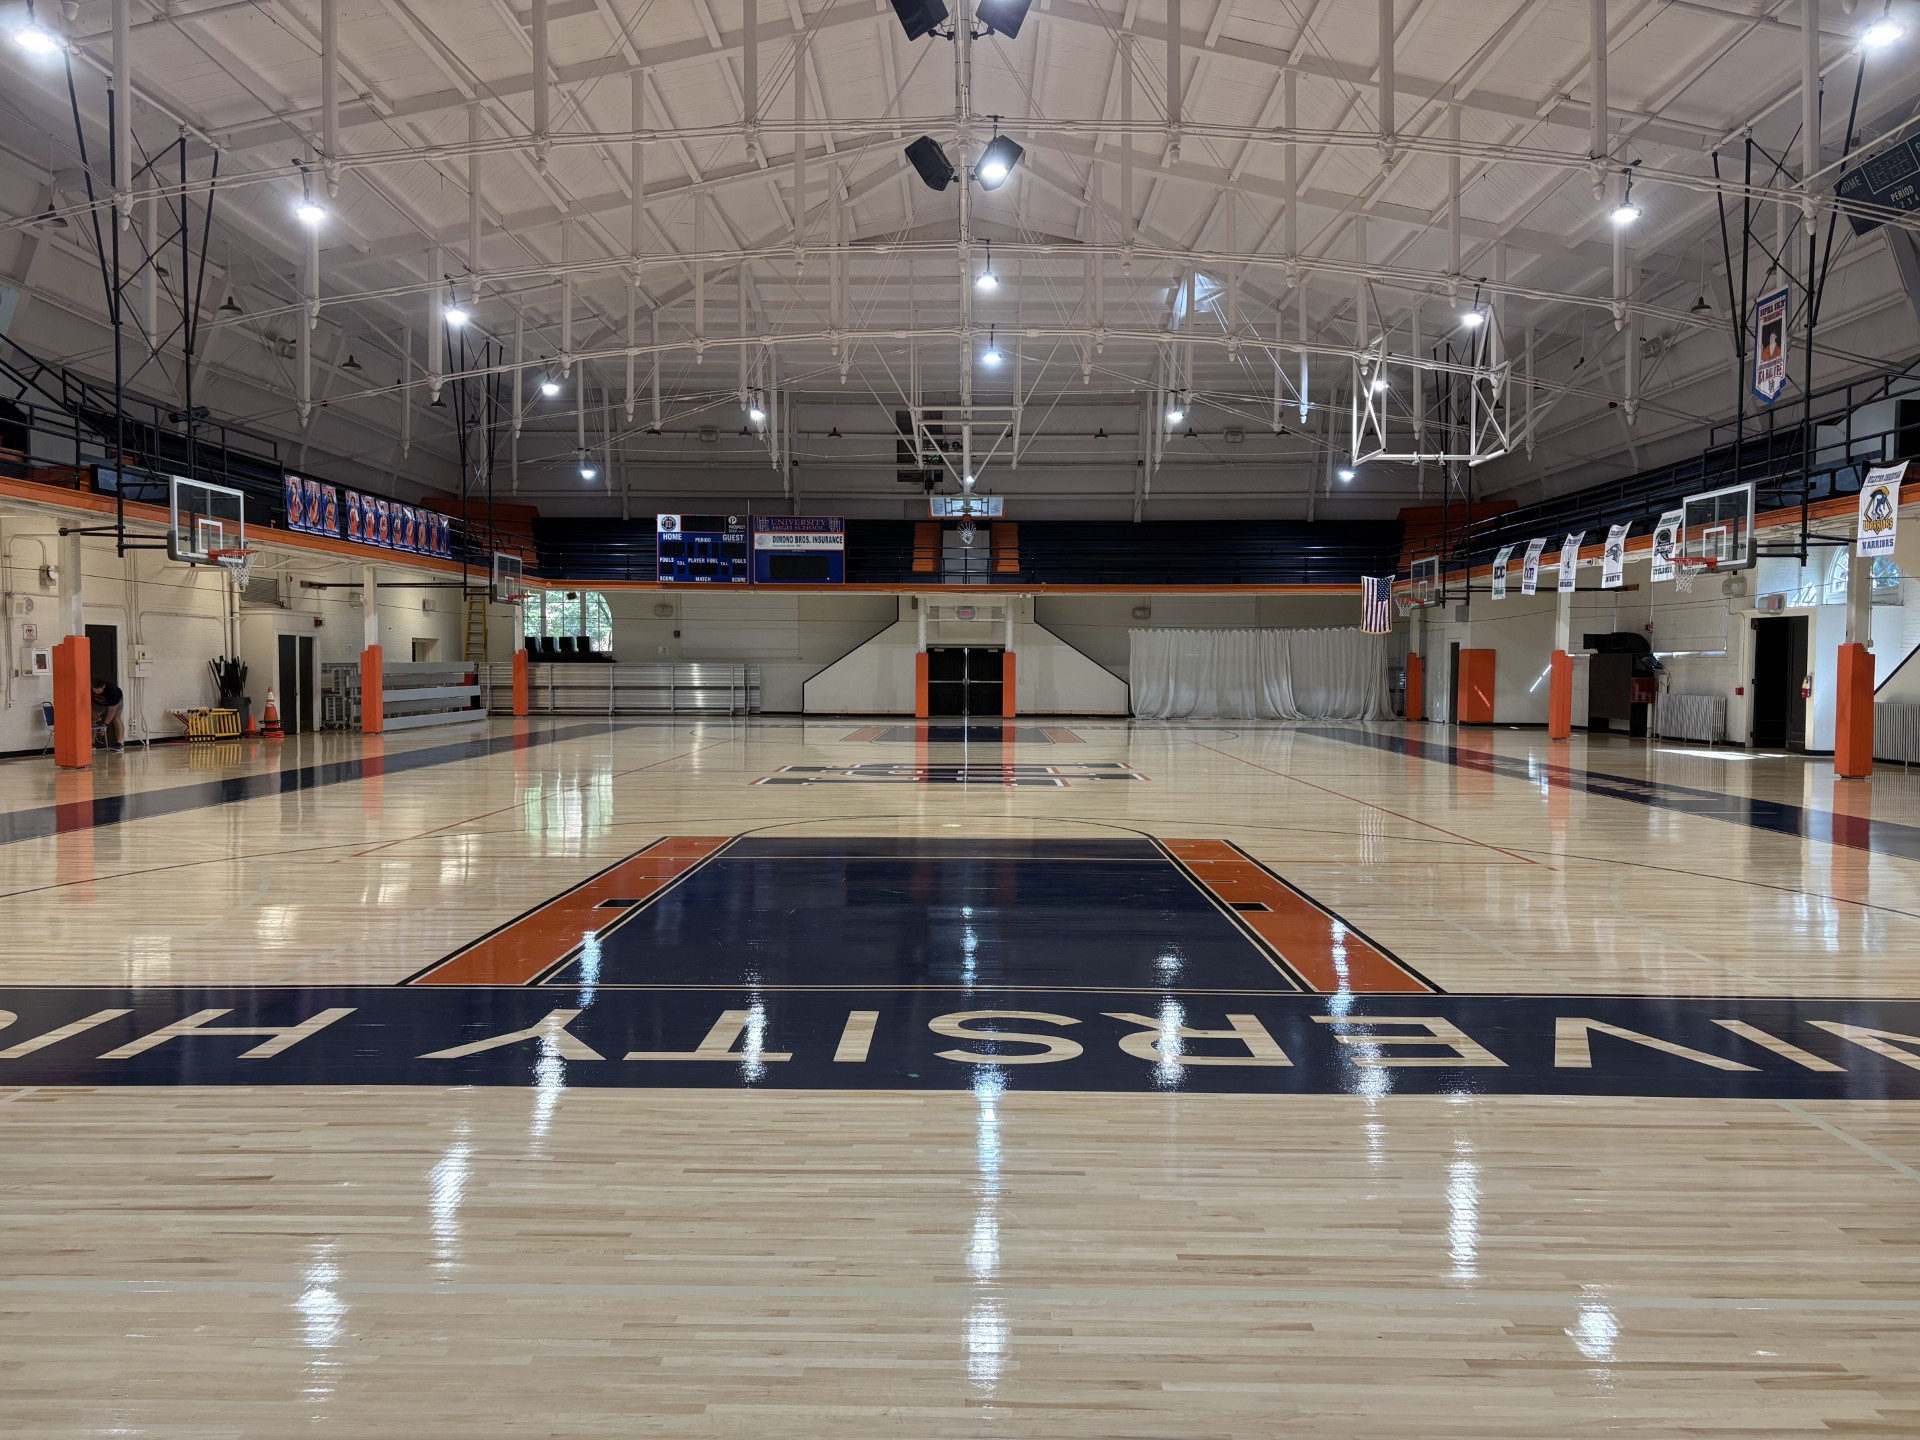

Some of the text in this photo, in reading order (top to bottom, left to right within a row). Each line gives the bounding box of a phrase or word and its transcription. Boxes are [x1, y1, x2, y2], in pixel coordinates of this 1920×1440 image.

[1840, 176, 1862, 195] HOME
[1890, 185, 1915, 202] PERIOD
[1900, 201, 1906, 209] 2
[1914, 193, 1920, 201] 4
[662, 533, 682, 541] HOME
[722, 533, 744, 542] GUEST
[772, 535, 843, 544] DIMOND BROS. INSURANCE
[1862, 538, 1894, 550] WARRIORS
[0, 1007, 1920, 1072] IVERSITY HI
